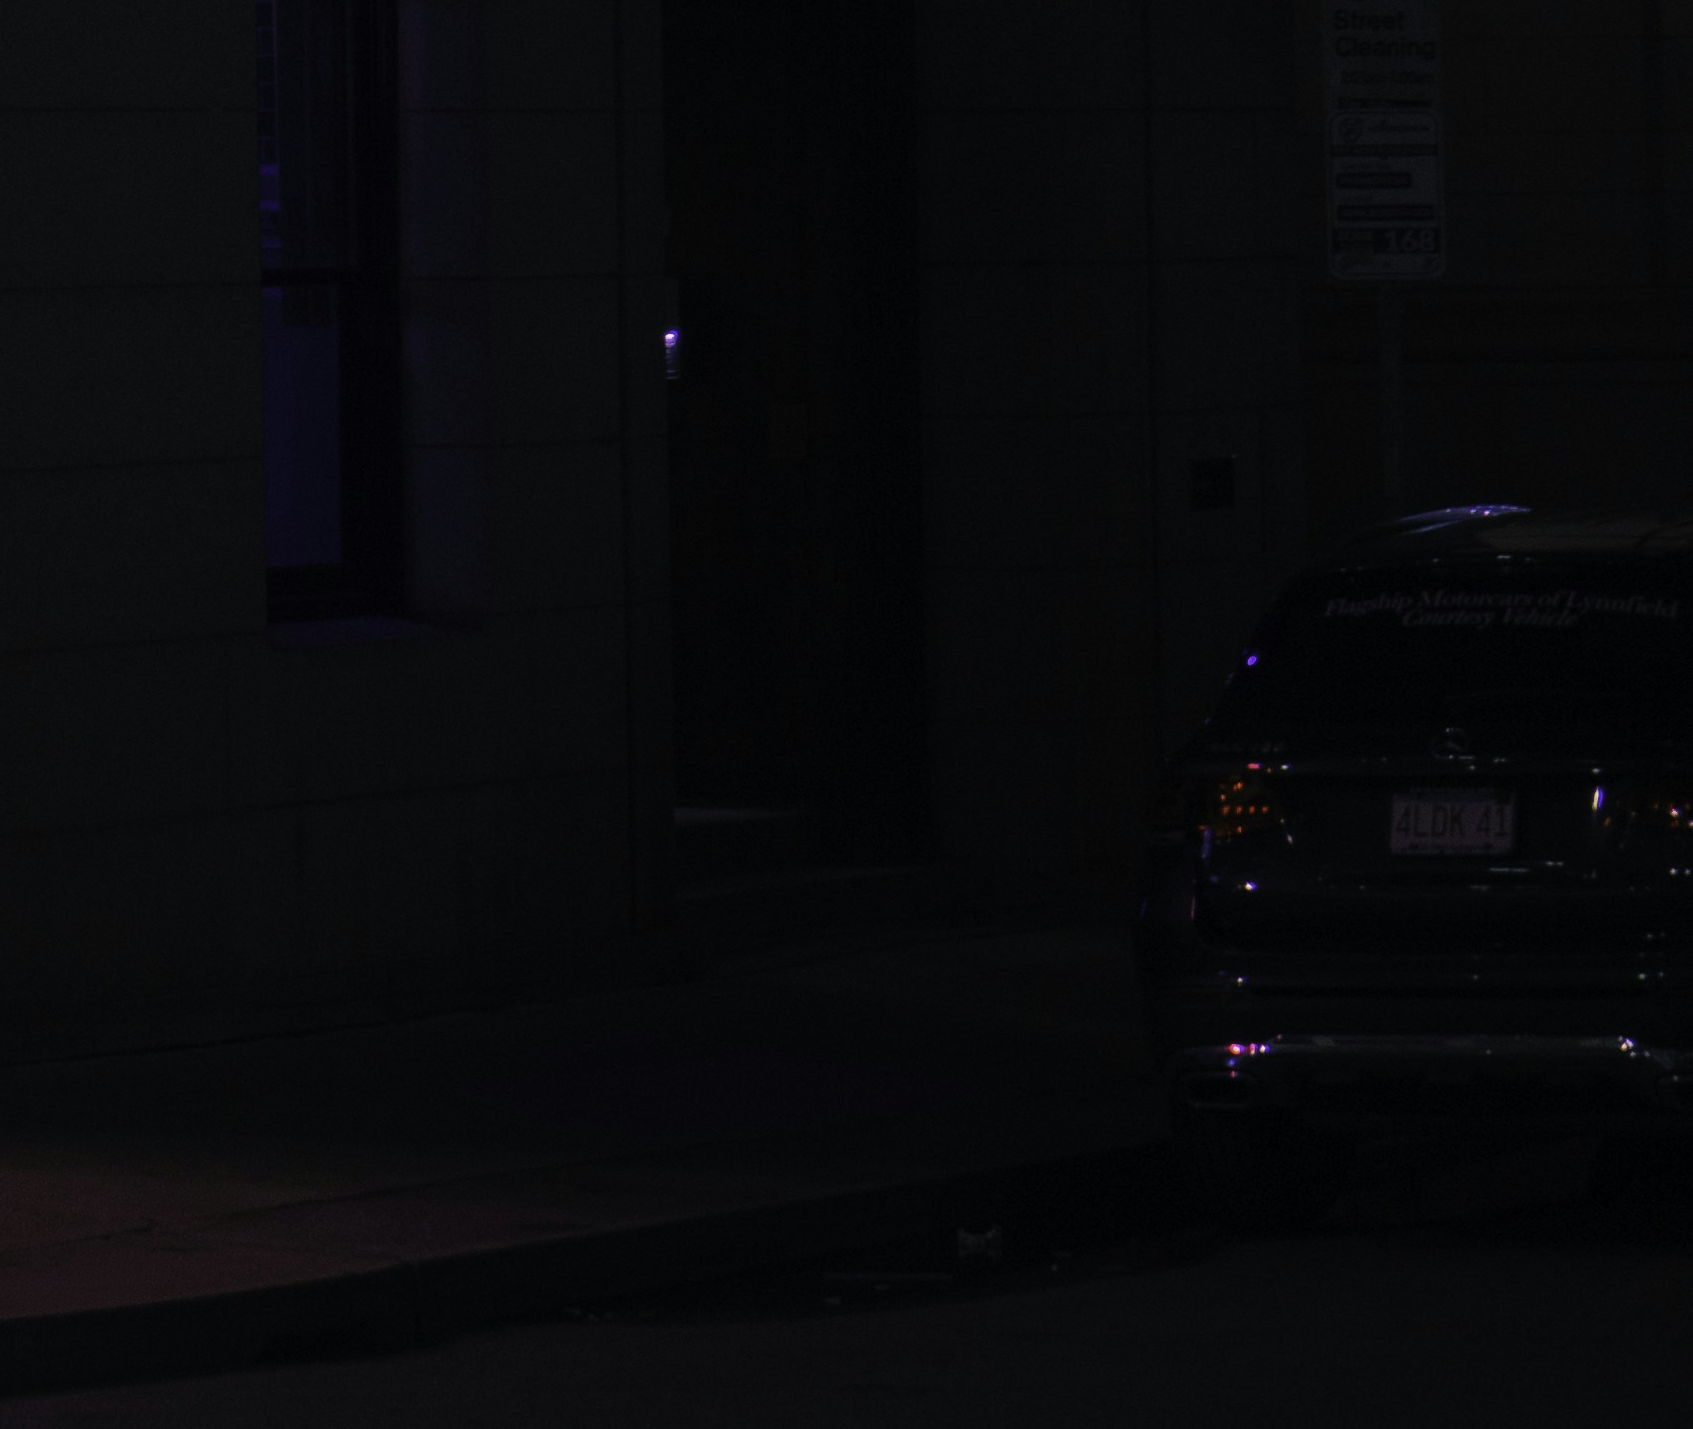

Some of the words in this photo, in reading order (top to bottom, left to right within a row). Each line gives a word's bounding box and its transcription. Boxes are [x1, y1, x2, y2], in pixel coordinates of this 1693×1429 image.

[1334, 9, 1405, 30] Street
[1335, 36, 1436, 61] Cleaning
[1384, 229, 1435, 253] 168
[1324, 591, 1413, 617] Flagship
[1418, 589, 1533, 608] Motorcars
[1537, 589, 1565, 607] of
[1566, 590, 1680, 619] Lynnfield
[1401, 608, 1495, 631] Courtesy
[1503, 607, 1579, 628] Vehicle
